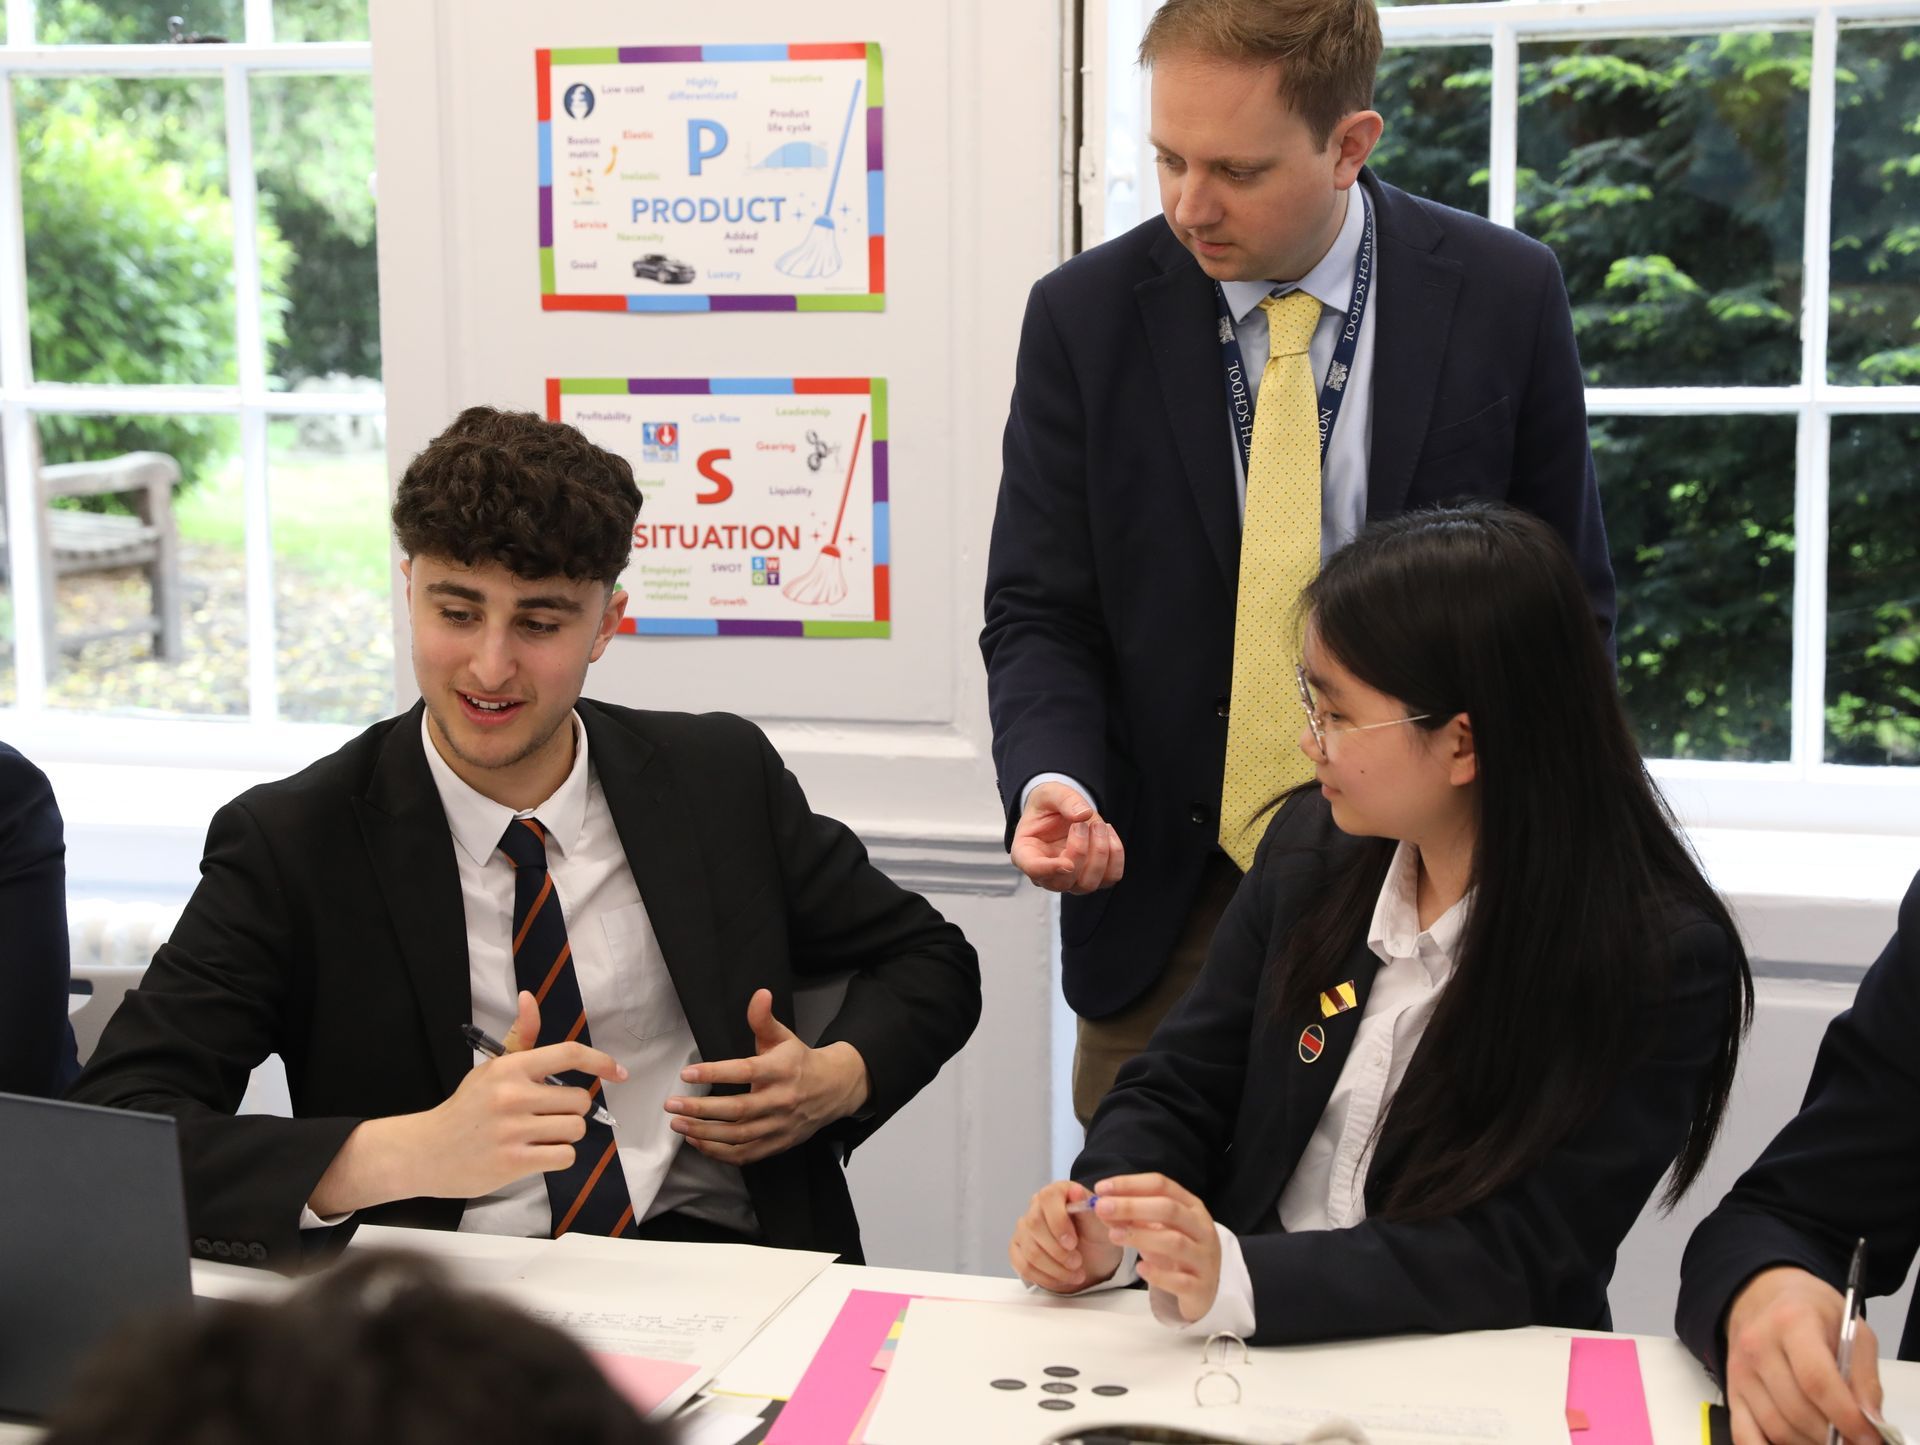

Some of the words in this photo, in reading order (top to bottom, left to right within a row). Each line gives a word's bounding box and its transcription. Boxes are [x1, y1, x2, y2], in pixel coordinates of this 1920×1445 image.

[686, 77, 719, 89] Highly
[770, 74, 824, 84] Innovative
[601, 85, 621, 94] Low
[624, 85, 645, 94] cost
[668, 91, 738, 100] differentiated
[770, 109, 810, 118] Product
[767, 122, 782, 132] life
[786, 123, 812, 135] cycle
[567, 136, 600, 145] Boston
[622, 130, 654, 140] Elastic
[688, 118, 729, 176] P
[632, 197, 787, 223] PRODUCT
[573, 220, 608, 230] Service
[617, 232, 664, 243] Necessity
[724, 231, 759, 241] Added
[728, 245, 755, 254] value
[570, 260, 597, 269] Good
[707, 270, 741, 280] Luxury
[1342, 281, 1366, 343] SCHOOL
[1228, 360, 1251, 423] SCHOOL
[576, 411, 632, 422] Profitability
[776, 407, 831, 418] Leadership
[692, 414, 715, 424] Cash
[719, 413, 741, 423] flow
[756, 441, 796, 453] Gearing
[696, 448, 734, 504] S
[769, 486, 812, 497] Liquidity
[633, 524, 800, 549] SITUATION
[711, 563, 742, 573] SWOT
[643, 579, 690, 590] employee
[646, 592, 689, 601] relations
[709, 596, 748, 606] Growth
